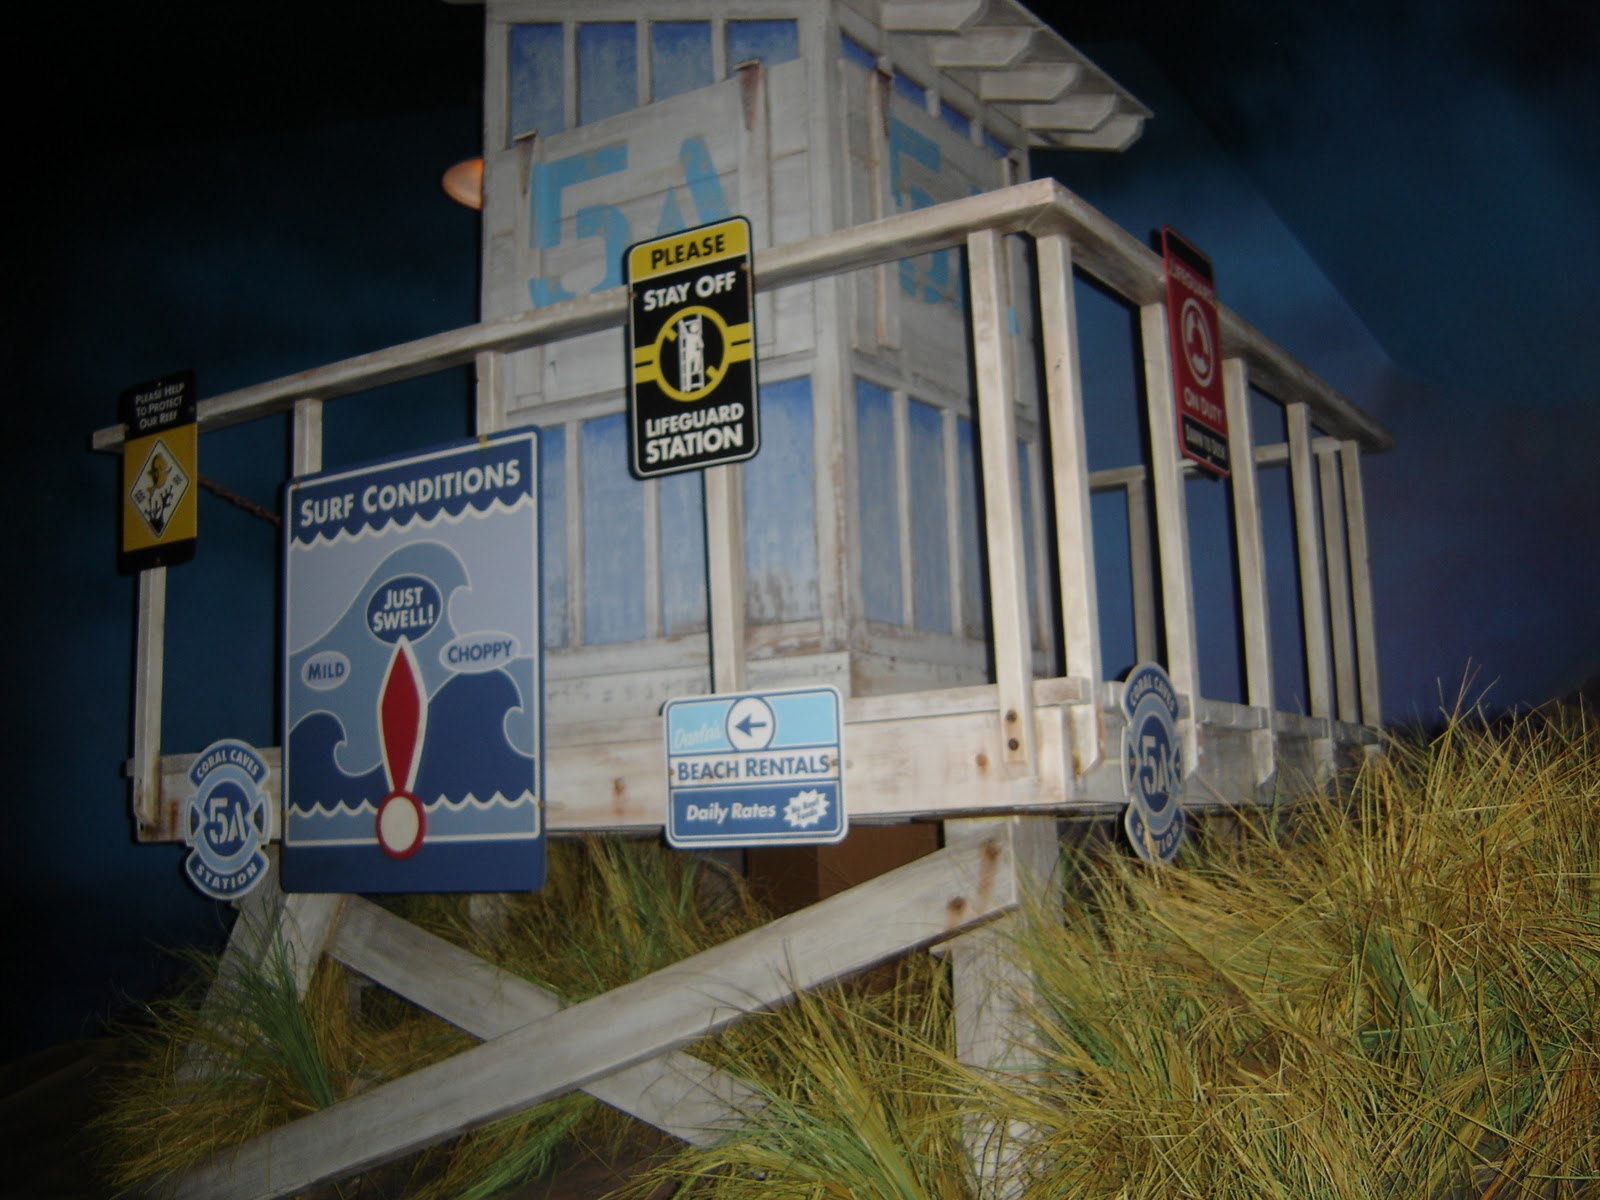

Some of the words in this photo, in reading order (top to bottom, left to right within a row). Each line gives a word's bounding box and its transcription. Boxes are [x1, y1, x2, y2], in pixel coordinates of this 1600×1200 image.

[651, 234, 725, 270] PLEASE
[643, 281, 691, 311] STAY
[695, 270, 736, 298] OFF
[135, 388, 162, 406] PLEASE
[164, 382, 185, 396] HELP
[136, 406, 147, 417] TO
[148, 395, 183, 414] PROTECT
[1183, 386, 1200, 411] ON
[139, 415, 158, 431] OUR
[159, 409, 178, 424] REEF
[645, 402, 744, 438] LIFEGUARD
[645, 422, 743, 464] STATION
[300, 493, 354, 527] SURF
[362, 459, 520, 514] CONDITIONS
[384, 586, 424, 610] JUST
[373, 604, 434, 633] SWELL!
[447, 640, 513, 664] CHOPPY
[307, 661, 345, 681] MILD
[1129, 676, 1152, 707] CORAL
[195, 750, 227, 779] CORAL
[230, 749, 260, 777] CAVES
[677, 760, 739, 781] BEACH
[745, 754, 830, 777] RENTALS
[1141, 735, 1171, 795] 5A
[208, 797, 247, 845] 5A
[686, 802, 729, 825] Daily
[731, 802, 777, 819] Rates
[195, 861, 258, 890] STATION
